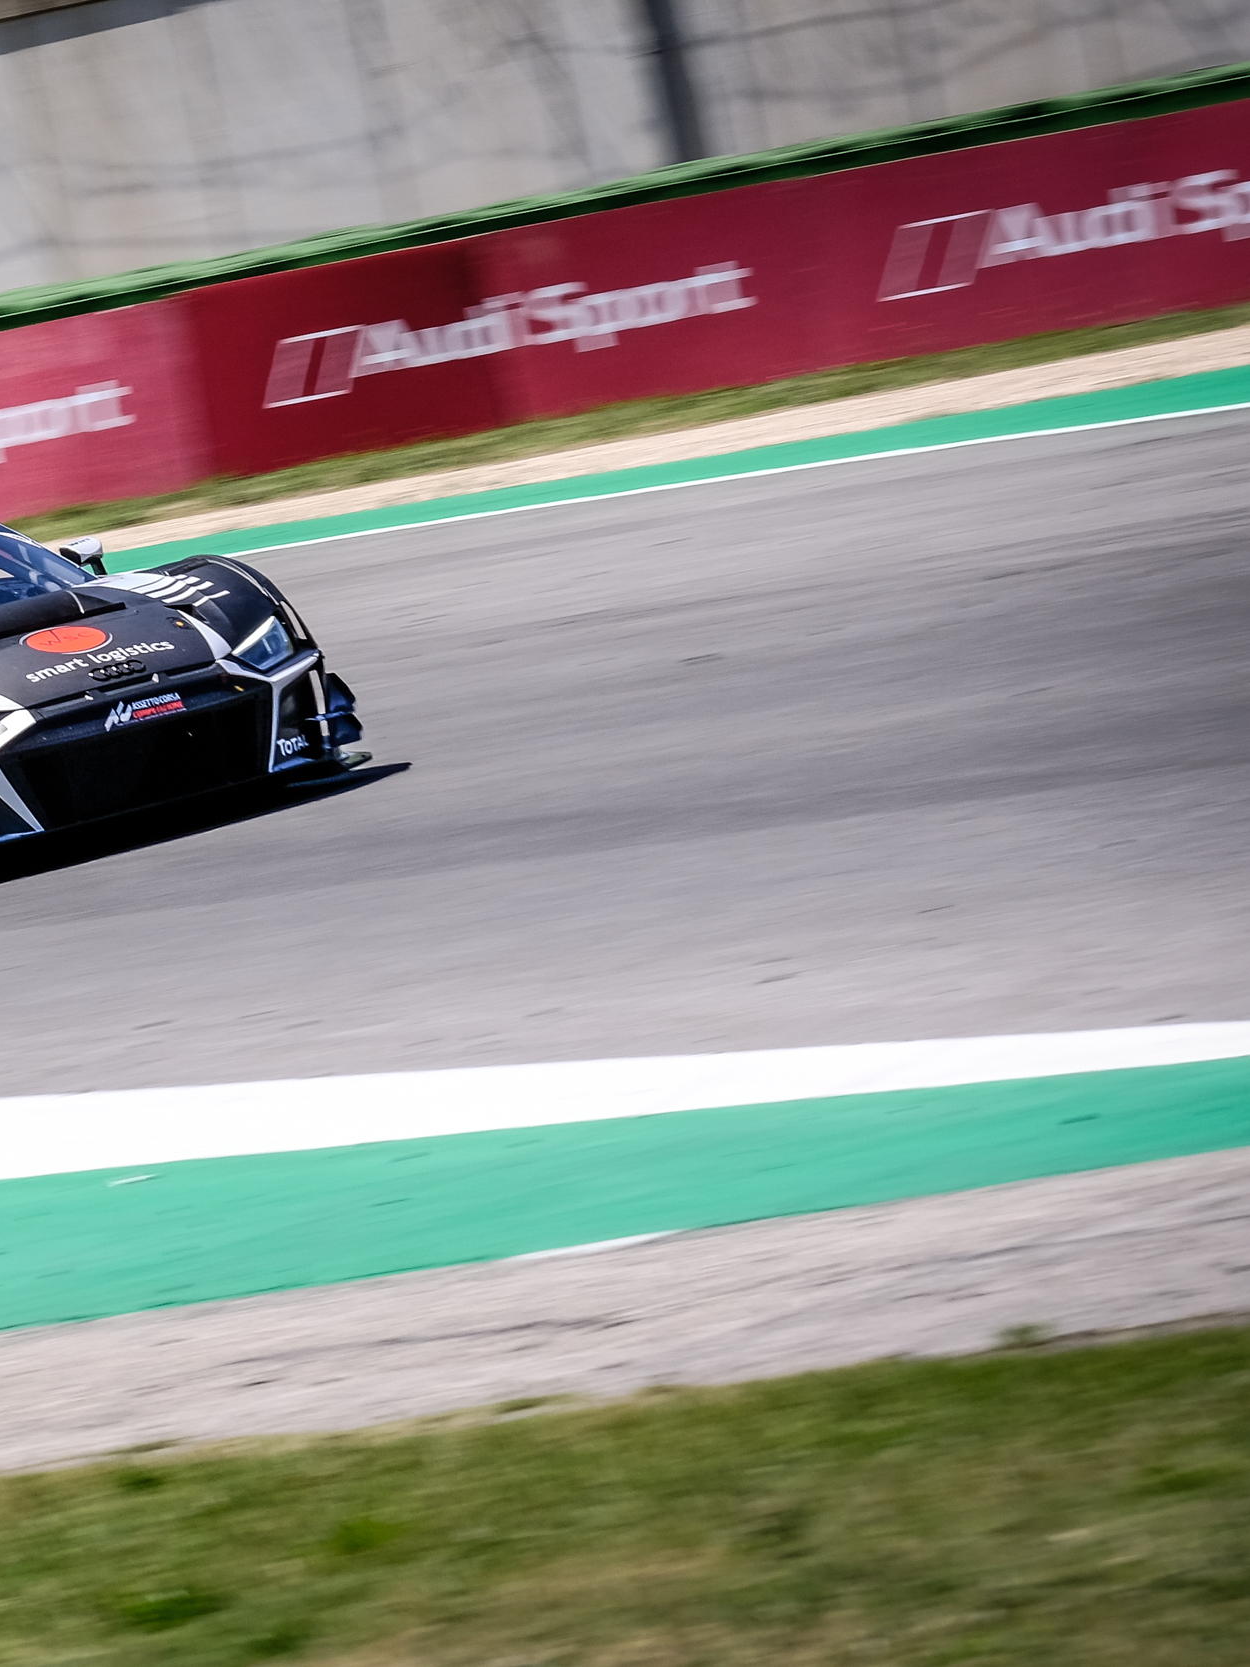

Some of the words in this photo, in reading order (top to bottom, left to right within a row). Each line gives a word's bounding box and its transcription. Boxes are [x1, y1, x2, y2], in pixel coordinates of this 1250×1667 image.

[976, 180, 1172, 269] Audi
[349, 291, 523, 378] Audi
[521, 261, 757, 353] Sport
[26, 657, 90, 683] smart
[87, 641, 176, 664] logistics
[276, 734, 310, 757] TOTAL
